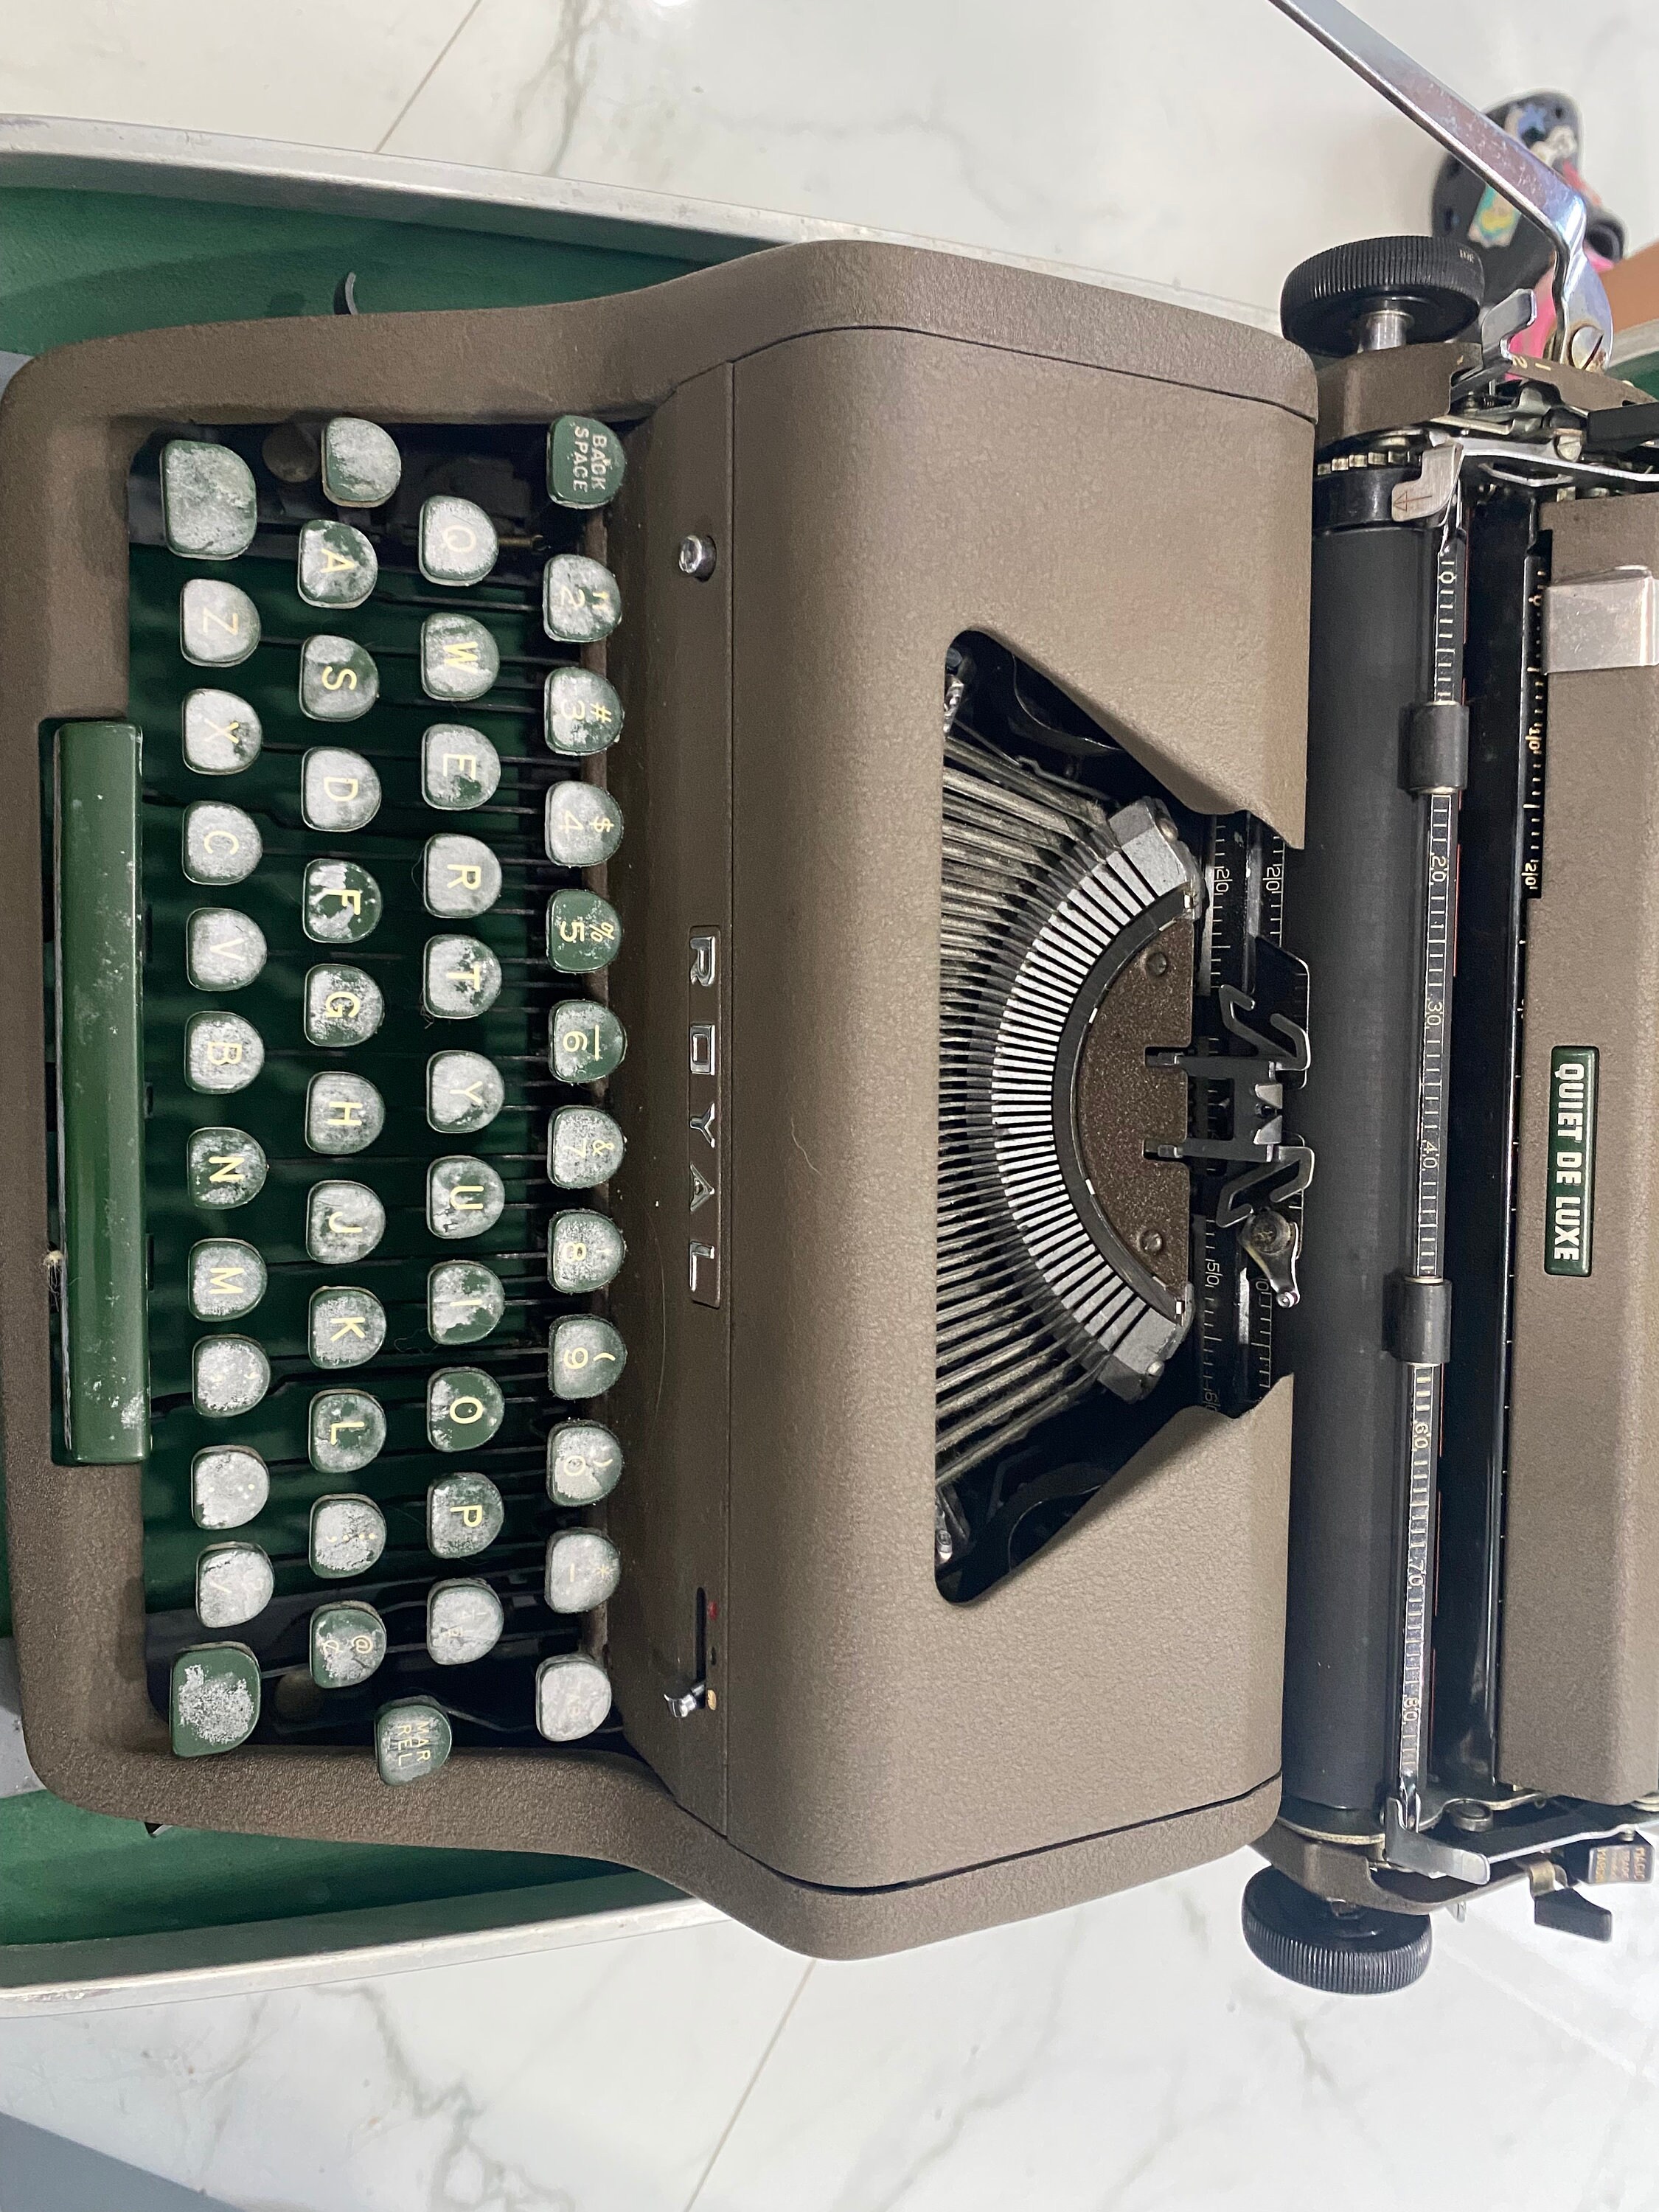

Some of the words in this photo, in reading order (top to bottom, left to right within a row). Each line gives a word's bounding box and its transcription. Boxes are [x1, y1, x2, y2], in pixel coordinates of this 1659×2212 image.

[572, 425, 588, 493] SPACE
[590, 434, 609, 490] BACK
[320, 548, 356, 574] A
[560, 586, 585, 608] 2
[201, 607, 238, 636] Z
[443, 641, 479, 676] W
[321, 665, 358, 690] S
[560, 700, 585, 720] 3
[591, 703, 612, 724] #
[204, 717, 239, 744] X
[443, 752, 476, 782] E
[324, 776, 358, 802] D
[560, 810, 584, 834] 4
[590, 817, 614, 833] $
[204, 830, 239, 855] C
[447, 864, 481, 889] R
[1217, 868, 1231, 892] 20
[1266, 866, 1281, 891] 20
[1432, 855, 1446, 882] 20
[1524, 862, 1537, 885] 20
[324, 888, 361, 915] F
[560, 921, 584, 942] 5
[589, 922, 615, 942] %
[209, 937, 245, 959] V
[446, 964, 480, 991] T
[326, 991, 361, 1018] G
[1427, 1001, 1443, 1026] 30
[208, 1041, 243, 1065] B
[563, 1031, 588, 1052] 6
[449, 1081, 483, 1105] Y
[1554, 1063, 1585, 1143] QUIET
[327, 1101, 363, 1126] H
[689, 935, 716, 1293] ROYAL
[563, 1138, 587, 1158] 7
[592, 1139, 615, 1157] &
[1423, 1141, 1439, 1169] 40
[209, 1156, 245, 1182] N
[1556, 1151, 1582, 1185] DE
[450, 1185, 484, 1210] U
[329, 1211, 363, 1234] J
[1554, 1196, 1581, 1261] LUXE
[563, 1242, 587, 1263] 8
[209, 1267, 245, 1295] M
[1206, 1262, 1220, 1287] 50
[330, 1316, 366, 1342] K
[563, 1347, 588, 1370] 9
[594, 1352, 616, 1362] (
[450, 1396, 484, 1424] O
[331, 1422, 364, 1446] L
[1414, 1423, 1429, 1449] 60
[563, 1455, 586, 1475] 0
[593, 1458, 613, 1467] )
[450, 1505, 483, 1528] P
[1408, 1559, 1425, 1585] 70
[351, 1635, 372, 1655] @
[1403, 1697, 1419, 1722] 80
[397, 1725, 413, 1766] REL
[414, 1720, 431, 1761] MAR
